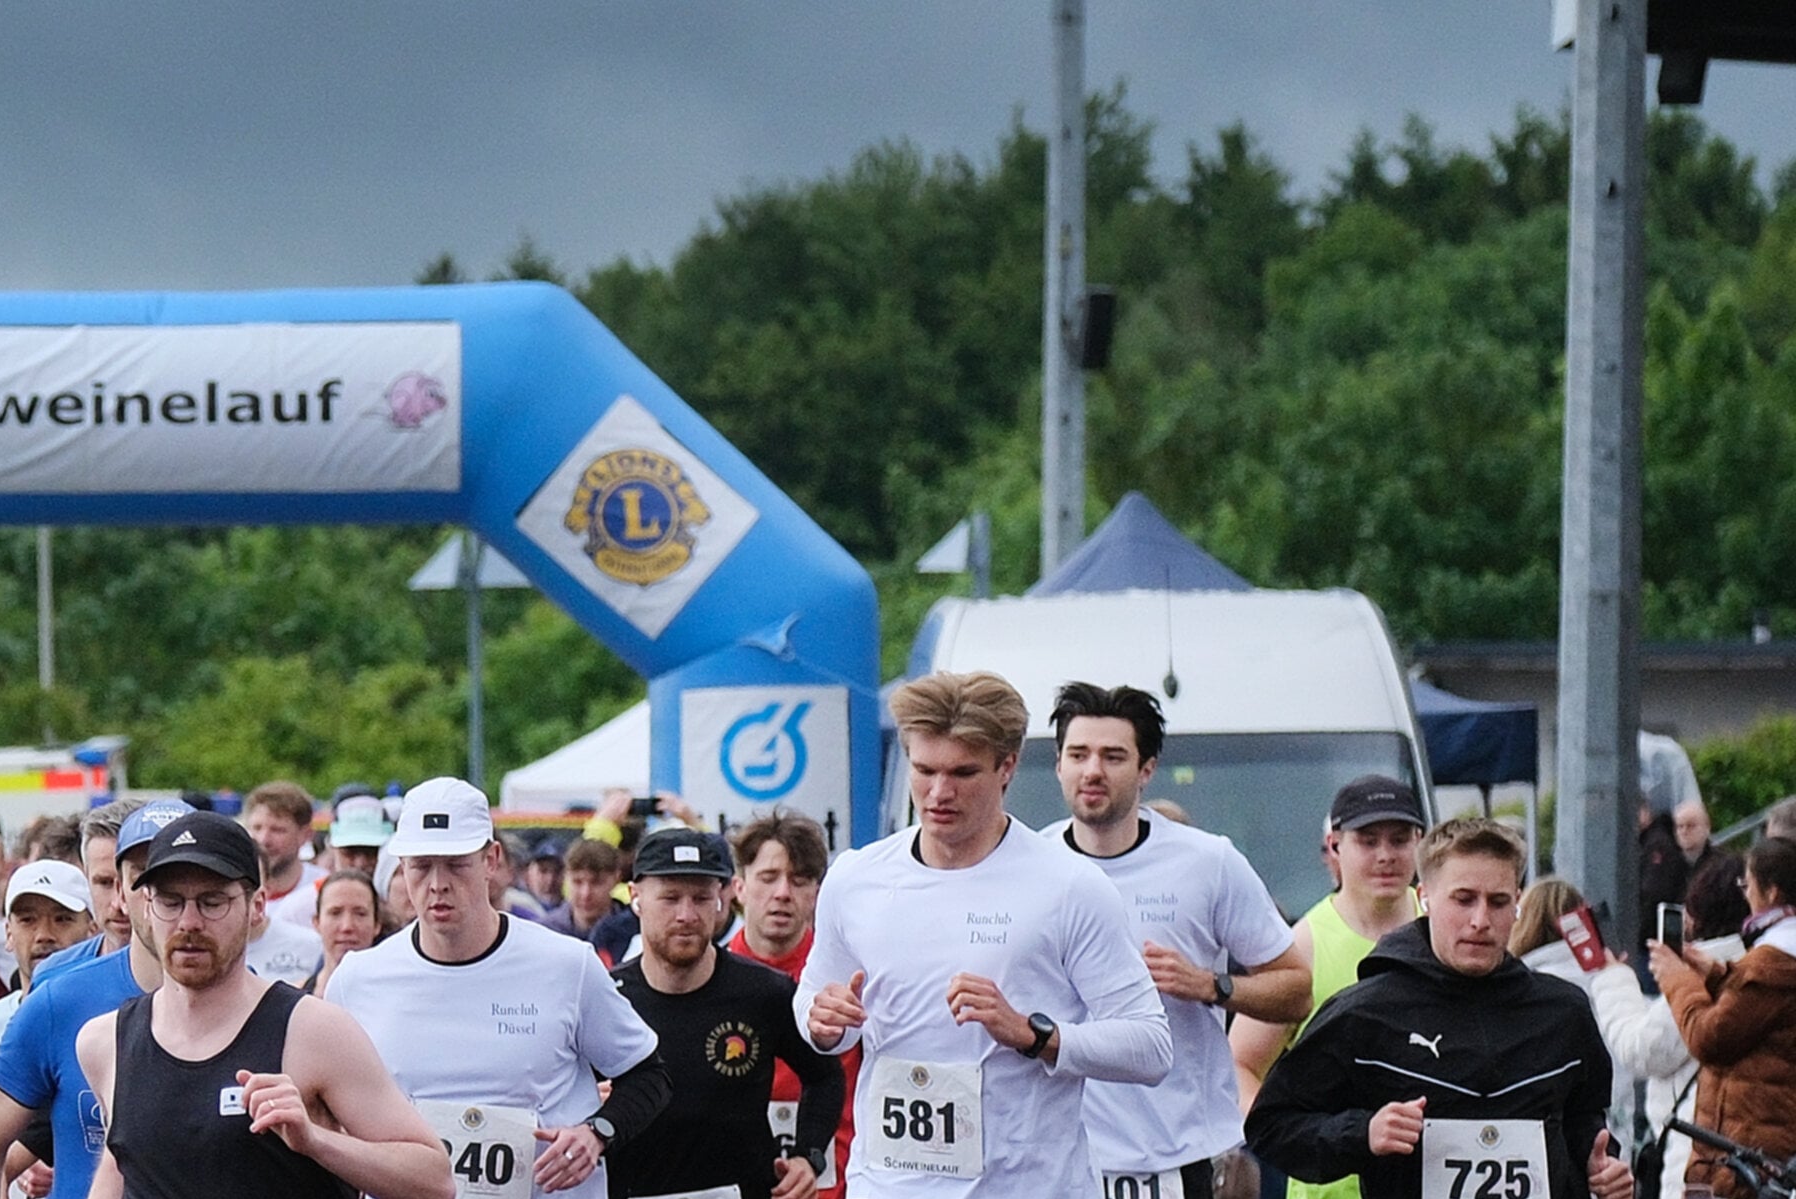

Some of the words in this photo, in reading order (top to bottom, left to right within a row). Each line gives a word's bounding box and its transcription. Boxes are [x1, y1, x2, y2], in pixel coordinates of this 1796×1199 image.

[620, 488, 662, 540] L
[967, 912, 1012, 925] Runclub
[491, 1003, 539, 1016] Runclub
[498, 1022, 535, 1035] Düssel
[882, 1096, 955, 1144] 581
[440, 1138, 514, 1185] 40
